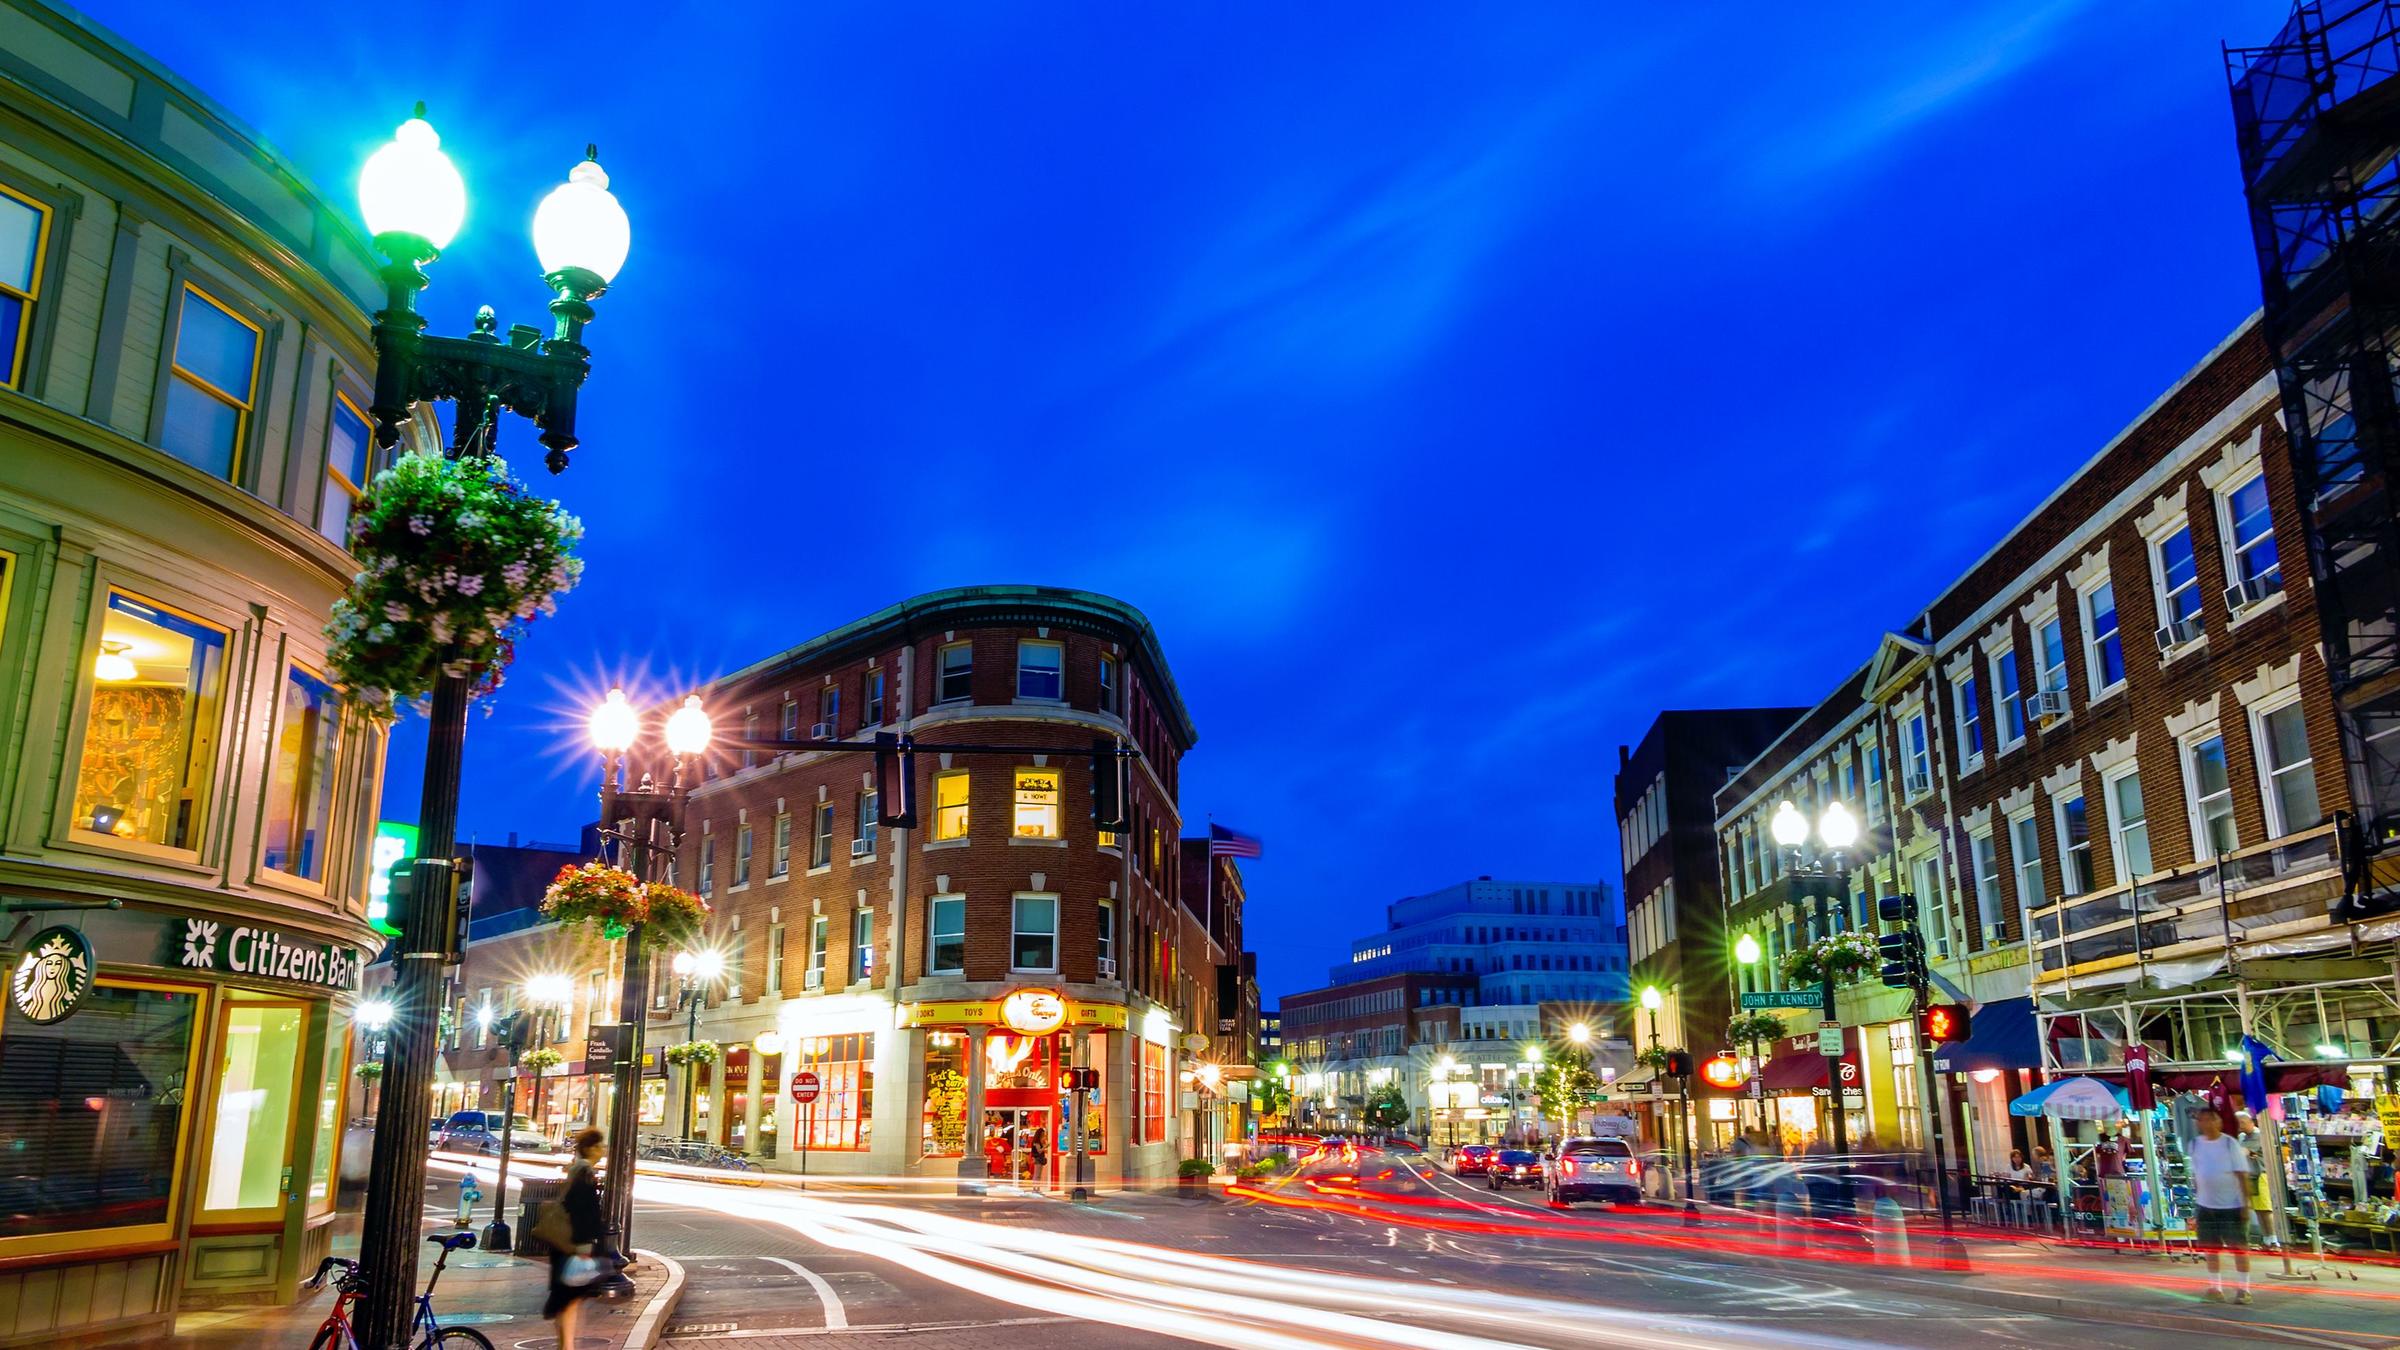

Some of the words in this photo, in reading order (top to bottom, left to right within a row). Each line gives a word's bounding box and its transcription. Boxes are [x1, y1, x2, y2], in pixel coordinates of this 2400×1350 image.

[229, 926, 326, 984] Citizens
[1743, 994, 1766, 1006] JOHN
[1769, 994, 1777, 1006] F.
[1780, 993, 1820, 1005] KENNEDY
[964, 1008, 983, 1016] TOYS
[1081, 1009, 1097, 1018] GIFTS
[588, 1053, 606, 1061] Square
[1022, 1066, 1047, 1087] Only
[1812, 1086, 1863, 1097] Sanches
